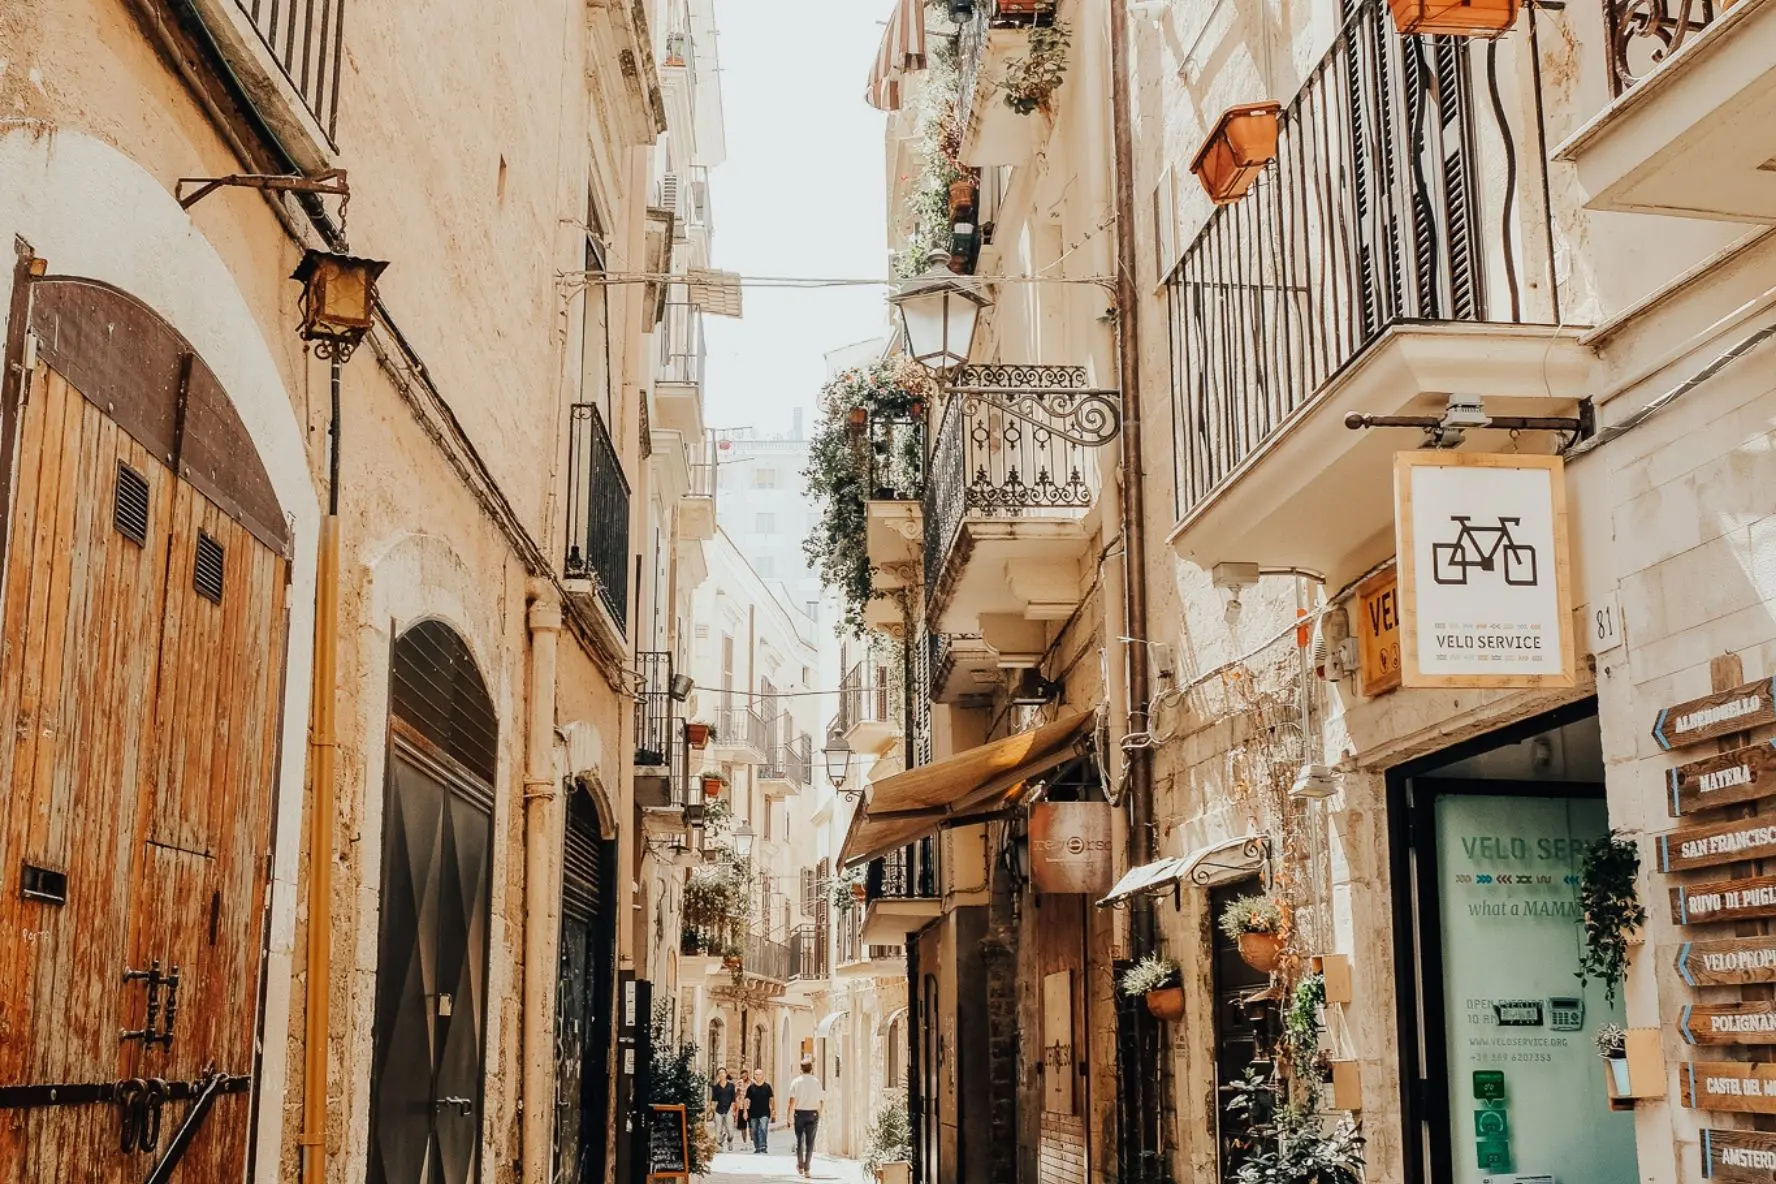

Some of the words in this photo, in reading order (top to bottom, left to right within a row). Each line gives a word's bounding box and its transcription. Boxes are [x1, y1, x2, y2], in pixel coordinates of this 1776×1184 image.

[1596, 605, 1613, 639] 81
[1436, 635, 1473, 649] VELO
[1477, 635, 1541, 649] SERVICE
[1699, 764, 1751, 792] MATERA
[1461, 836, 1526, 861] VELO
[1681, 839, 1708, 858] SAN
[1469, 899, 1505, 917] what
[1511, 904, 1519, 916] a
[1688, 893, 1721, 913] RUVO
[1725, 891, 1739, 909] DI
[1742, 885, 1776, 907] PUGL
[1703, 952, 1737, 971] VELO
[1706, 1077, 1742, 1095] CASTEL
[1743, 1079, 1762, 1096] DEL
